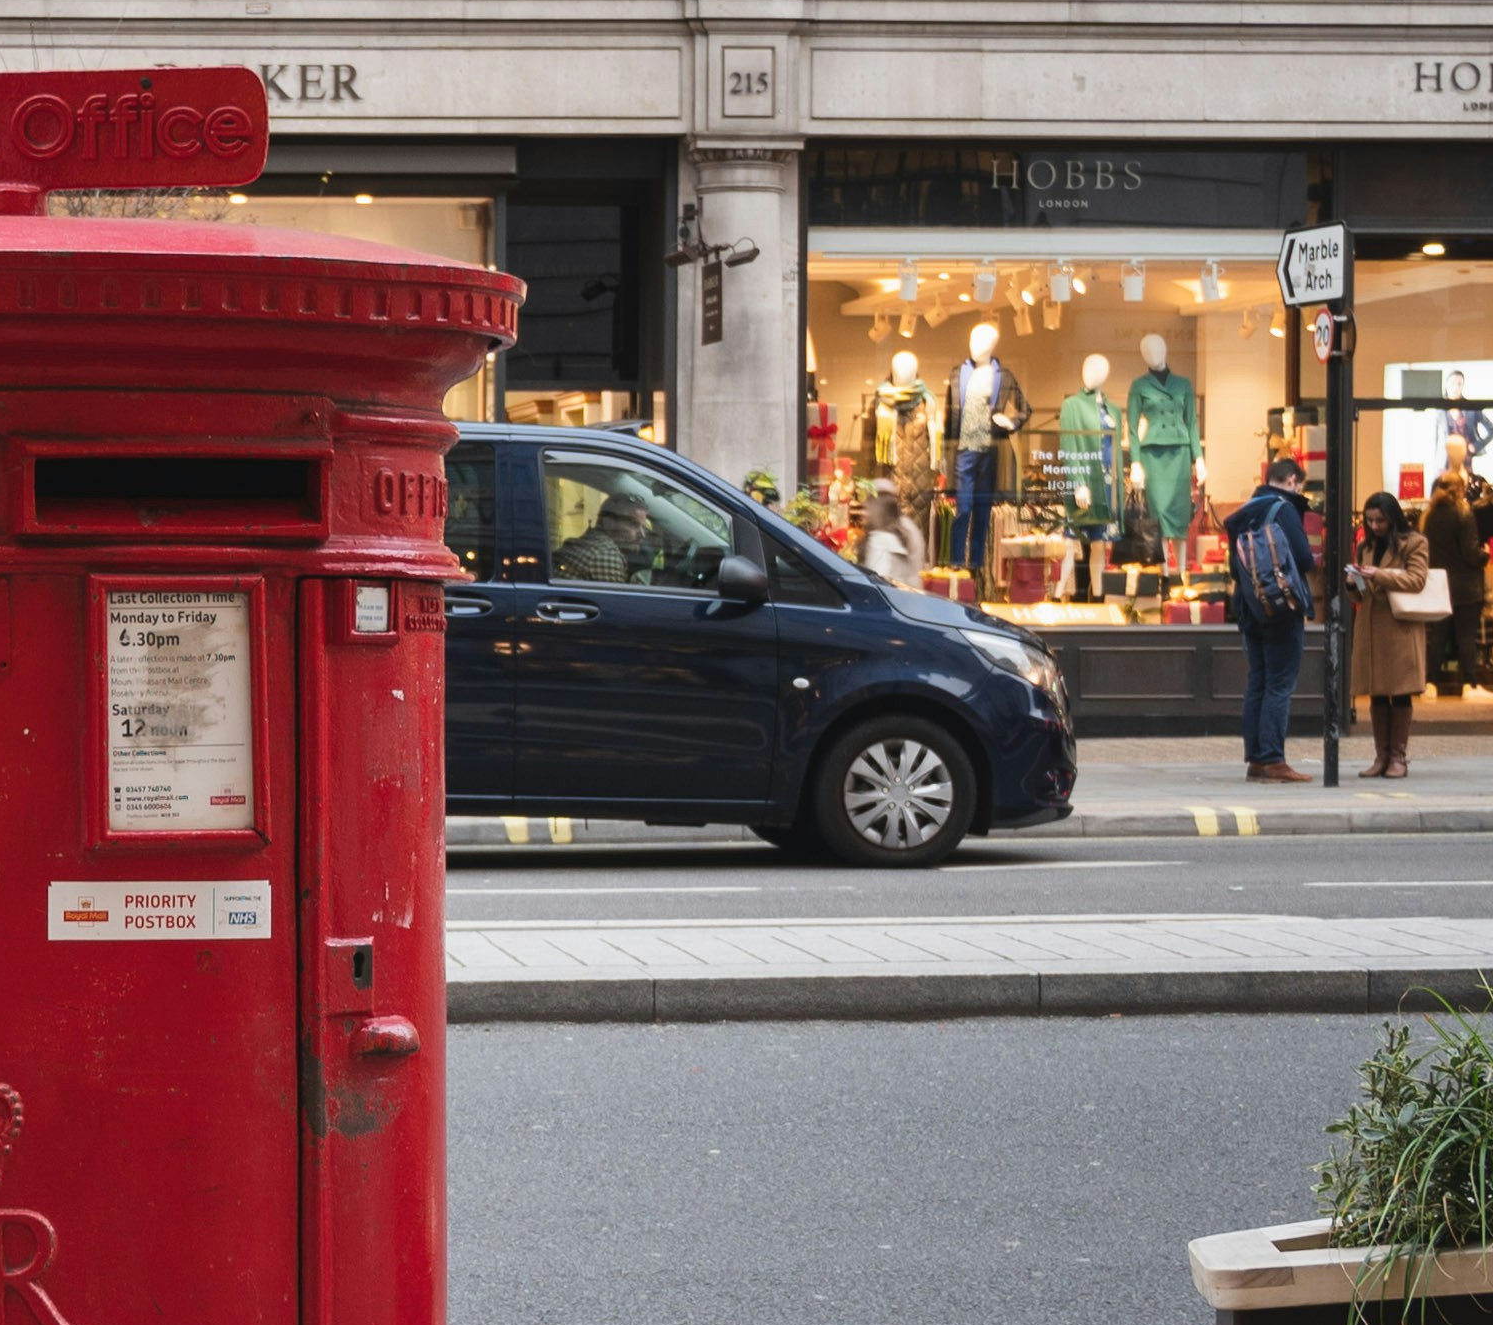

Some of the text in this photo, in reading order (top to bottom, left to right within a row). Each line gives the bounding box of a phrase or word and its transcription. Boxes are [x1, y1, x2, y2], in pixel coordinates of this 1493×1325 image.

[728, 71, 769, 96] 215
[12, 92, 253, 162] Office
[991, 159, 1144, 192] HOBBS
[1038, 198, 1089, 210] LONDON
[1298, 237, 1339, 263] Marble
[1304, 269, 1332, 292] Arch
[1315, 325, 1331, 347] 20
[1031, 450, 1103, 461] The Present
[1043, 464, 1091, 475] Moment
[110, 592, 235, 605] Last Collection Time
[110, 610, 217, 626] Monday to Friday
[119, 628, 180, 649] 6.30pm
[110, 655, 116, 663] A
[133, 654, 168, 663] ollection
[198, 654, 205, 662] at
[168, 676, 182, 685] Mail
[112, 703, 170, 717] Saturday
[121, 718, 188, 738] 12 noon
[132, 749, 167, 757] Collections
[148, 785, 172, 793] 740740
[126, 803, 143, 811] 0345
[124, 894, 197, 909] PRIORITY
[65, 910, 108, 923] Royal Mail
[124, 914, 197, 929] POSTBOX
[229, 912, 256, 925] NHS
